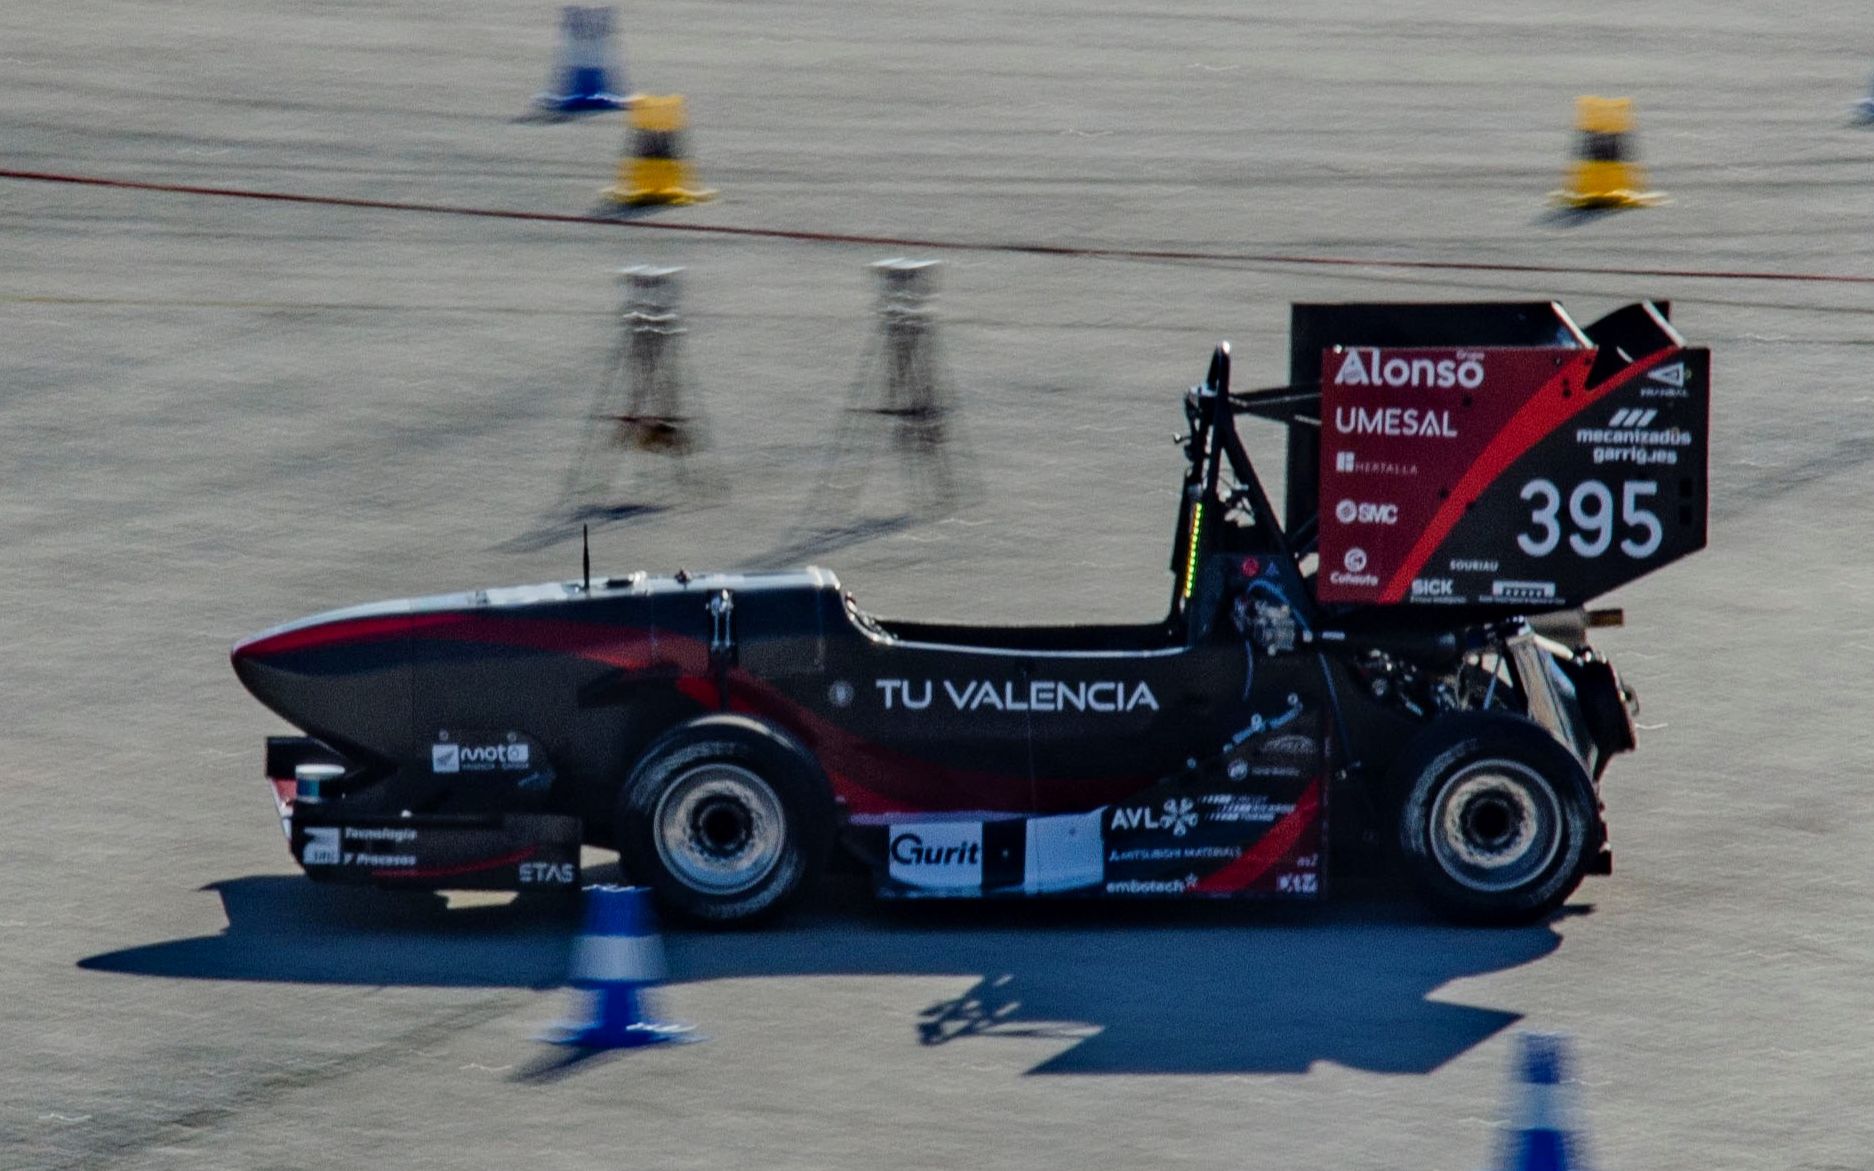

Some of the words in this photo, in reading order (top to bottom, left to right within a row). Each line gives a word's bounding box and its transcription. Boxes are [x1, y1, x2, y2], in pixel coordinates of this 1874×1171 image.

[1334, 347, 1484, 388] Alonso
[1335, 406, 1458, 437] UMESAL
[1358, 502, 1398, 524] SMC
[1516, 478, 1664, 559] 395
[1449, 560, 1499, 572] SOURIAU
[1411, 579, 1454, 595] SICK
[876, 679, 932, 709] TU
[943, 679, 1160, 712] VALENCIA
[1111, 806, 1159, 831] AVL
[890, 833, 979, 865] Gurit
[519, 862, 574, 883] ETAS
[1106, 879, 1185, 893] embotech
